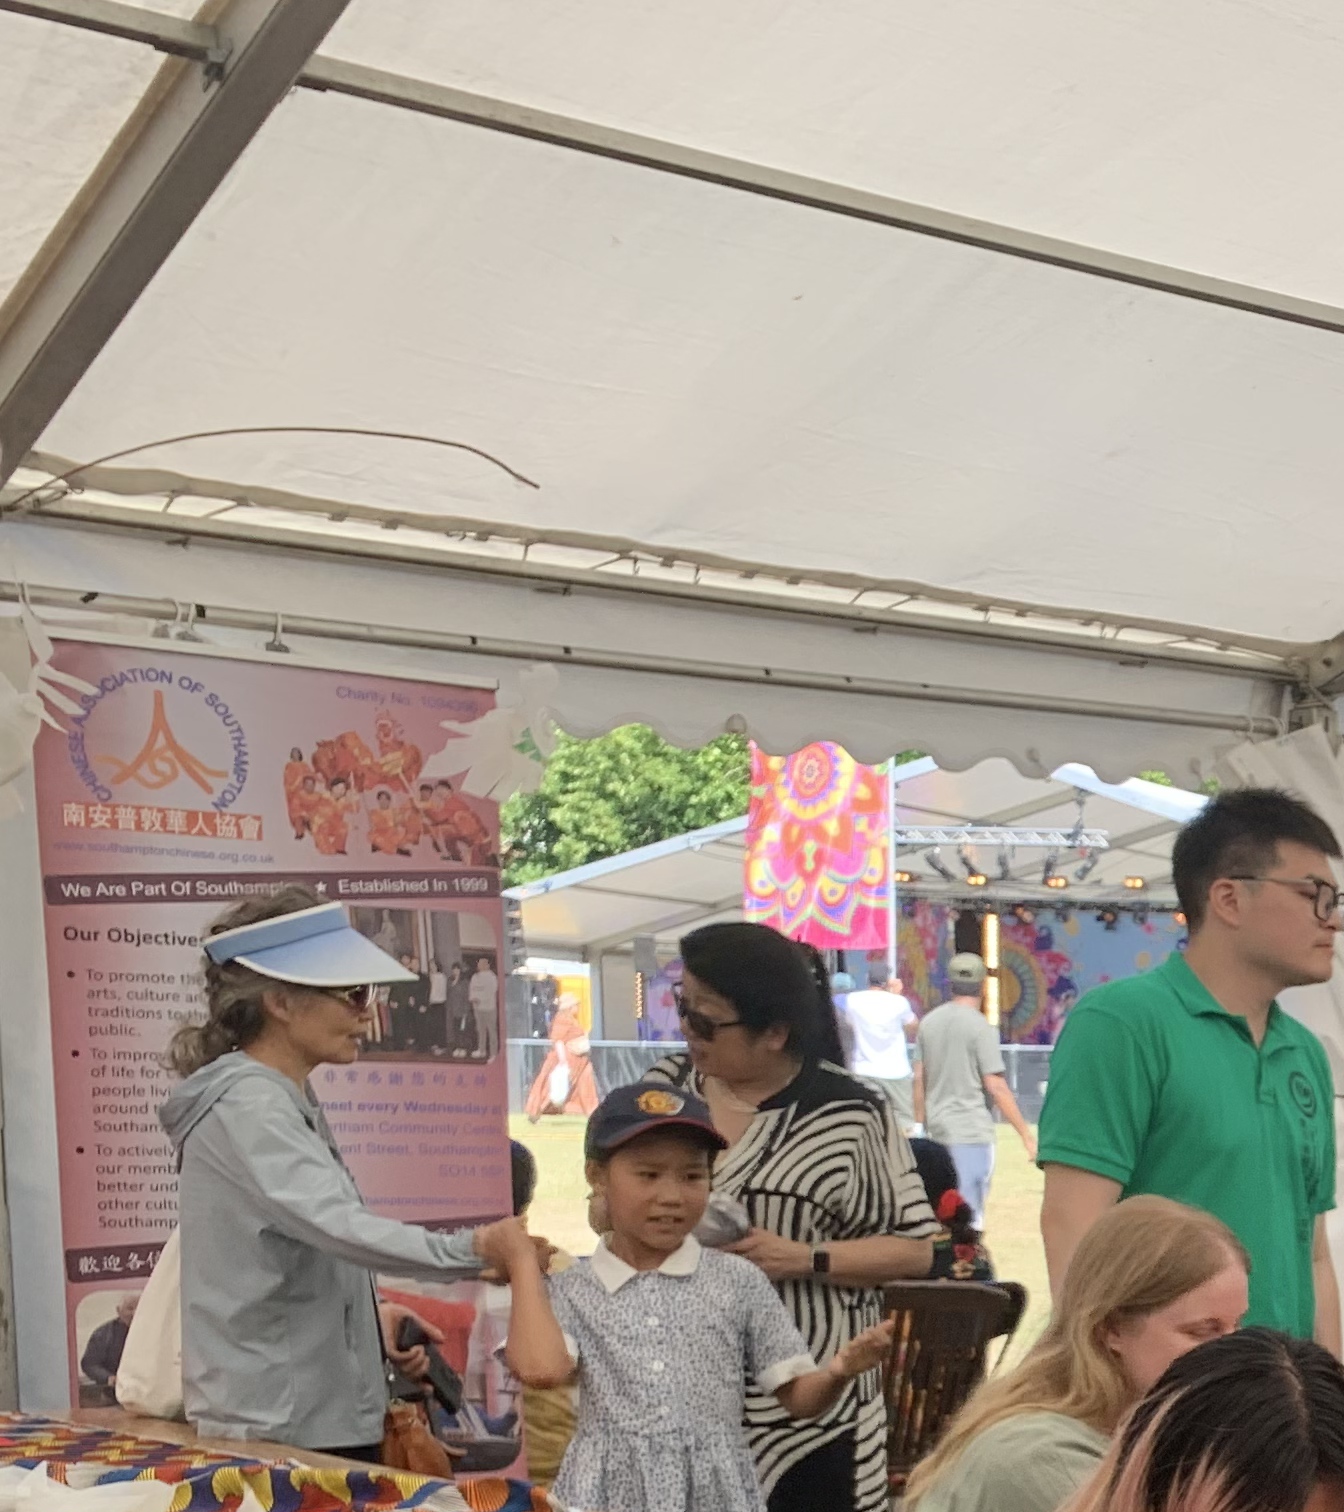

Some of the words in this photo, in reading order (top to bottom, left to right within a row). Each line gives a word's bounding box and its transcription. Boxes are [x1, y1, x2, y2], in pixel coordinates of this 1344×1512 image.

[178, 675, 205, 695] OF
[204, 692, 249, 812] SOUTHAMPTON
[63, 802, 260, 840] 南安普敦華人協會
[61, 883, 91, 897] We
[96, 882, 126, 896] Are
[131, 881, 166, 896] Part
[171, 881, 191, 895] Of
[338, 878, 429, 894] Established
[433, 878, 447, 892] In
[63, 926, 99, 941] Our
[87, 969, 103, 981] To
[109, 971, 175, 985] promote
[126, 987, 180, 1001] culture
[88, 1006, 163, 1020] traditions
[168, 1009, 181, 1021] to
[89, 1024, 141, 1037] public.
[91, 1048, 107, 1060] To
[91, 1067, 106, 1078] of
[111, 1067, 135, 1078] life
[140, 1067, 161, 1078] for
[92, 1085, 145, 1102] people
[92, 1102, 148, 1115] around
[357, 1102, 400, 1114] every
[405, 1102, 488, 1115] Wednesday
[94, 1144, 112, 1156] To
[95, 1165, 123, 1175] our
[97, 1180, 145, 1193] better
[97, 1199, 141, 1211] other
